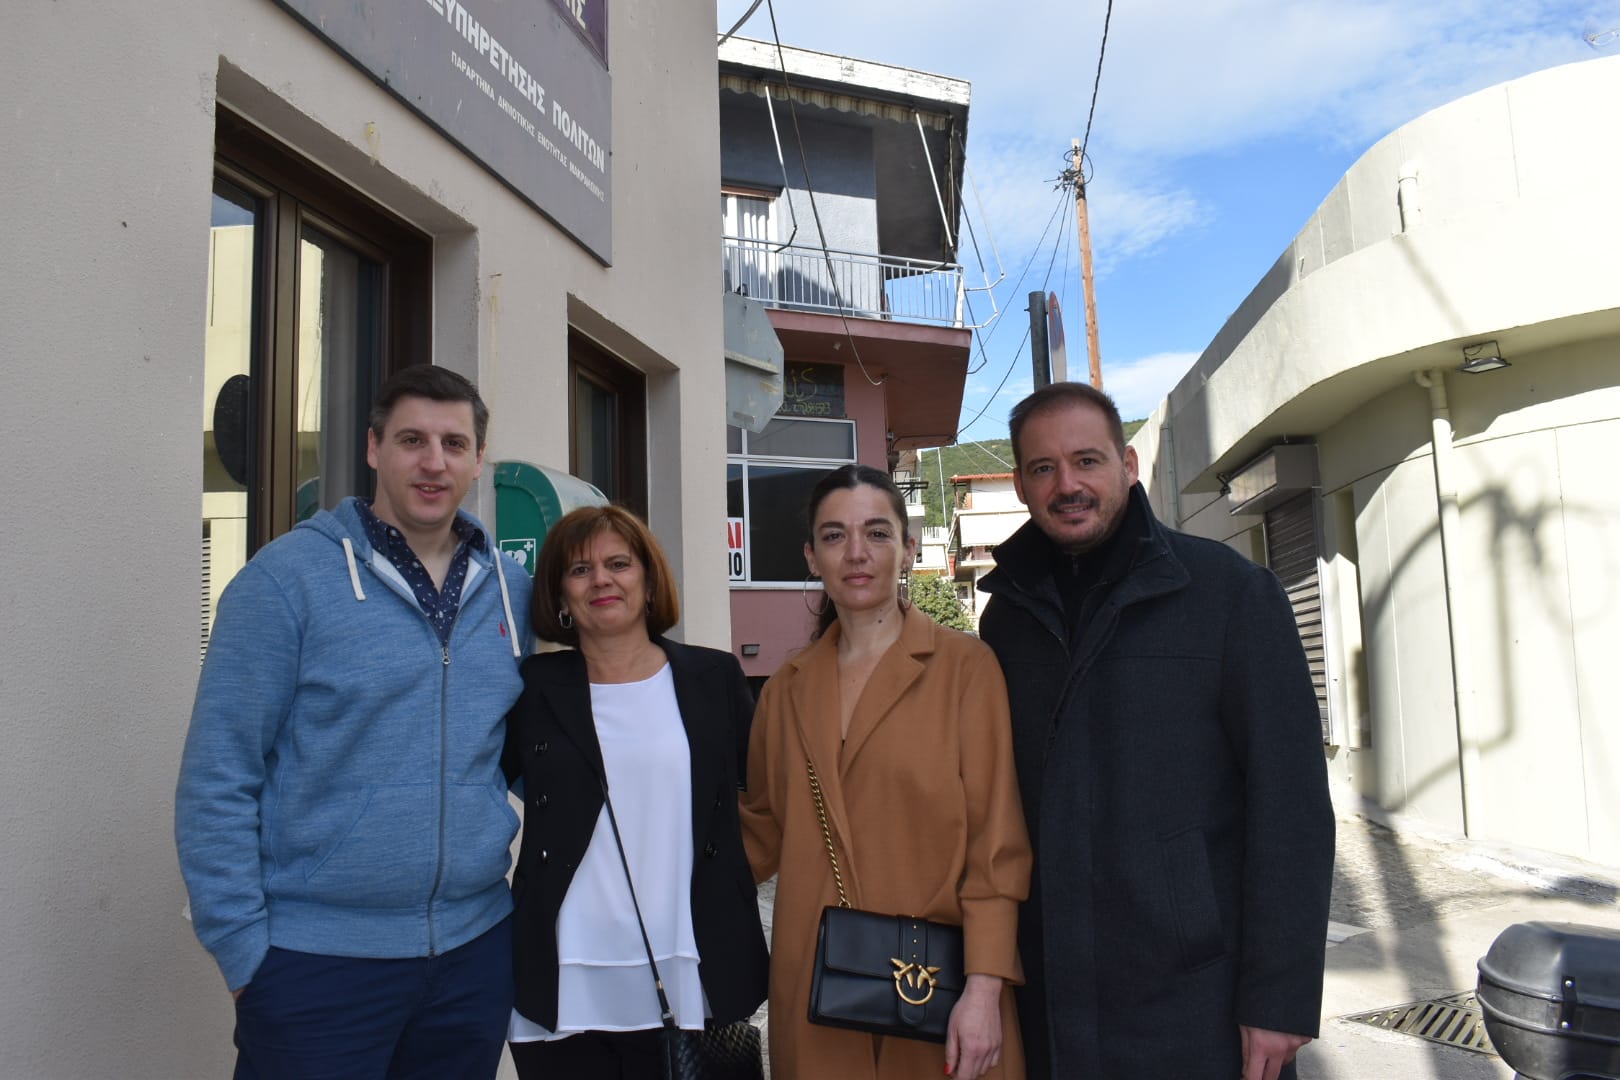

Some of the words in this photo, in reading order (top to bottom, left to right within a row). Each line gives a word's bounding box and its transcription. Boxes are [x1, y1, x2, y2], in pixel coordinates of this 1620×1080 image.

[427, 0, 546, 115] ΥΠΗΡΕΤΗΣΗΣ
[552, 100, 605, 174] ΠΟΛΙΤΩΝ
[451, 50, 495, 101] ΠΑΡΑΡΤΗΜΑ
[497, 95, 536, 137] ΔΗΜΟΤΙΚΗΣ
[537, 131, 568, 168] ΕΝΟΤΗΤΑΣ
